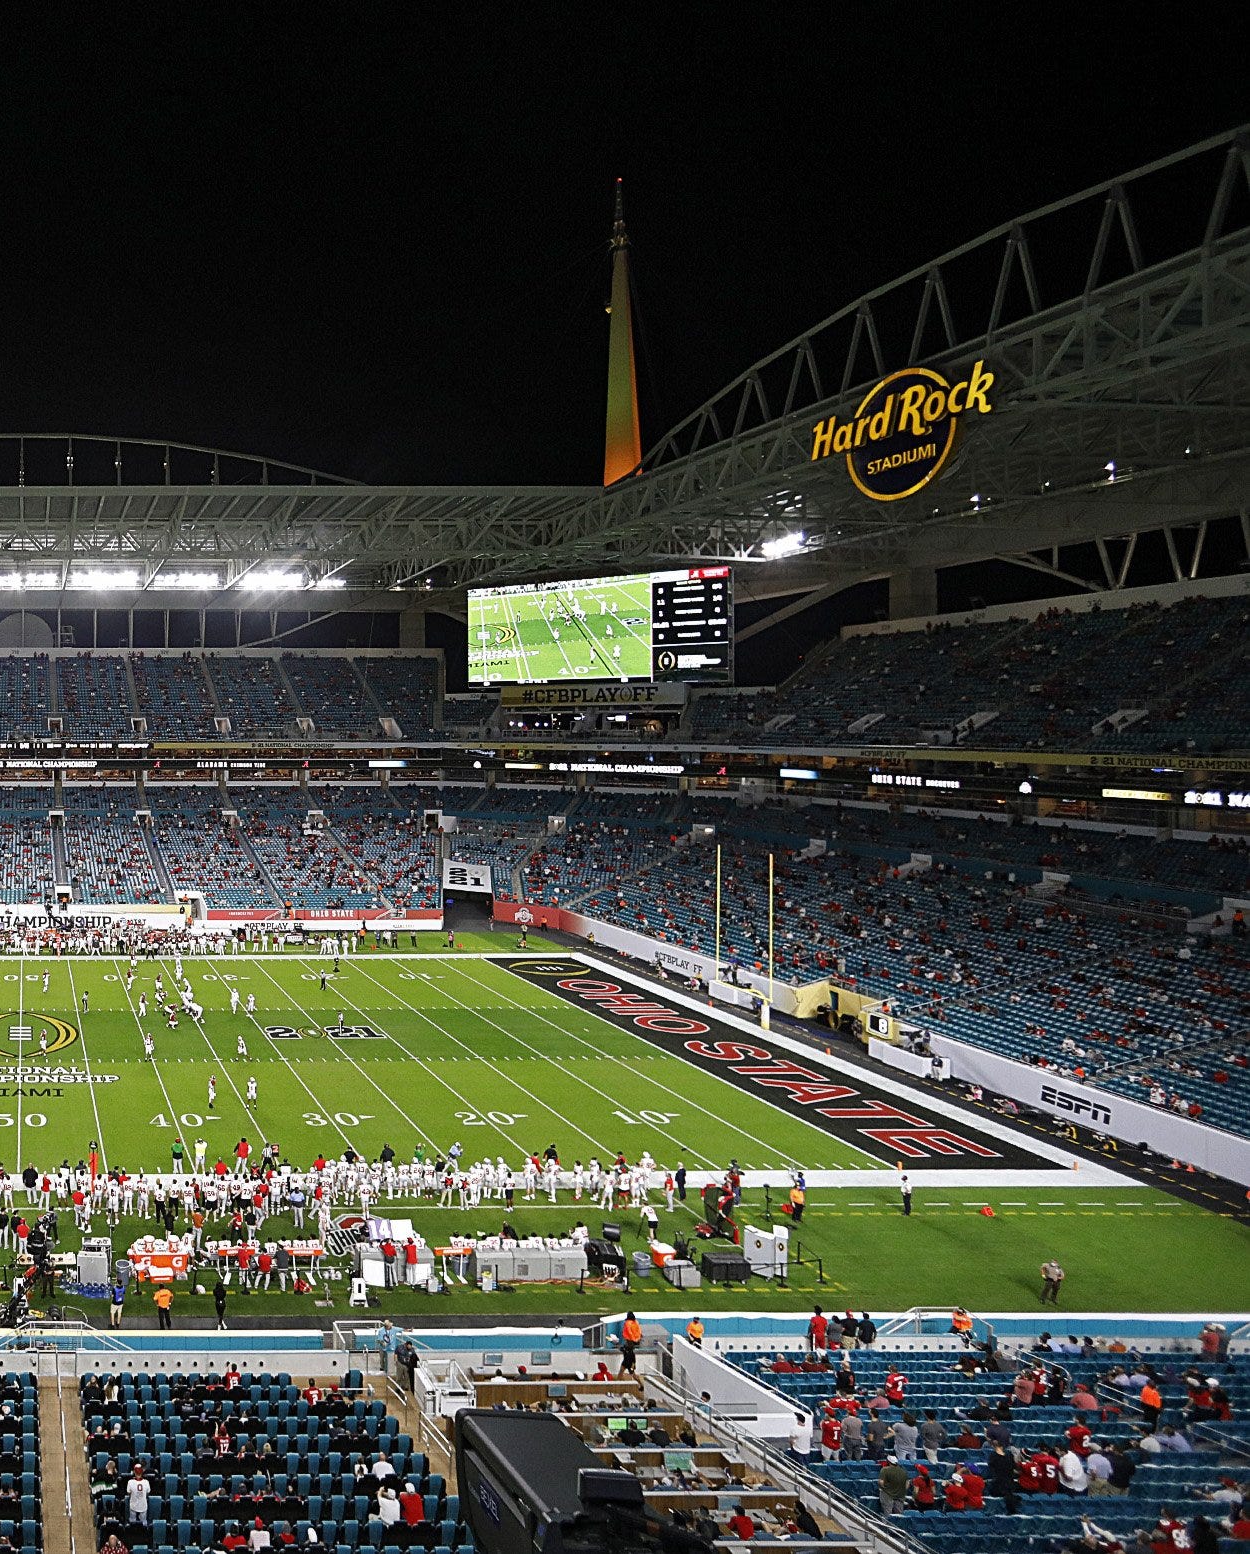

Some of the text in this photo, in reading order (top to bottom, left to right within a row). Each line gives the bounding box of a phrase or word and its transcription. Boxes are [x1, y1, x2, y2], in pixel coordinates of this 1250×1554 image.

[811, 360, 995, 462] Hard Rock
[1117, 758, 1177, 768] NATIONAL
[895, 775, 922, 787] STATE
[310, 909, 355, 918] OHIO STATE
[557, 978, 1004, 1159] OHIO STATE
[1041, 1084, 1112, 1125] ESPN
[149, 1113, 203, 1128] 40
[301, 1112, 361, 1127] 30
[454, 1111, 516, 1126] 20
[612, 1109, 672, 1125] 10
[171, 1256, 183, 1268] G
[833, 1430, 839, 1440] 1
[220, 1443, 229, 1454] 17
[1046, 1464, 1055, 1478] 5
